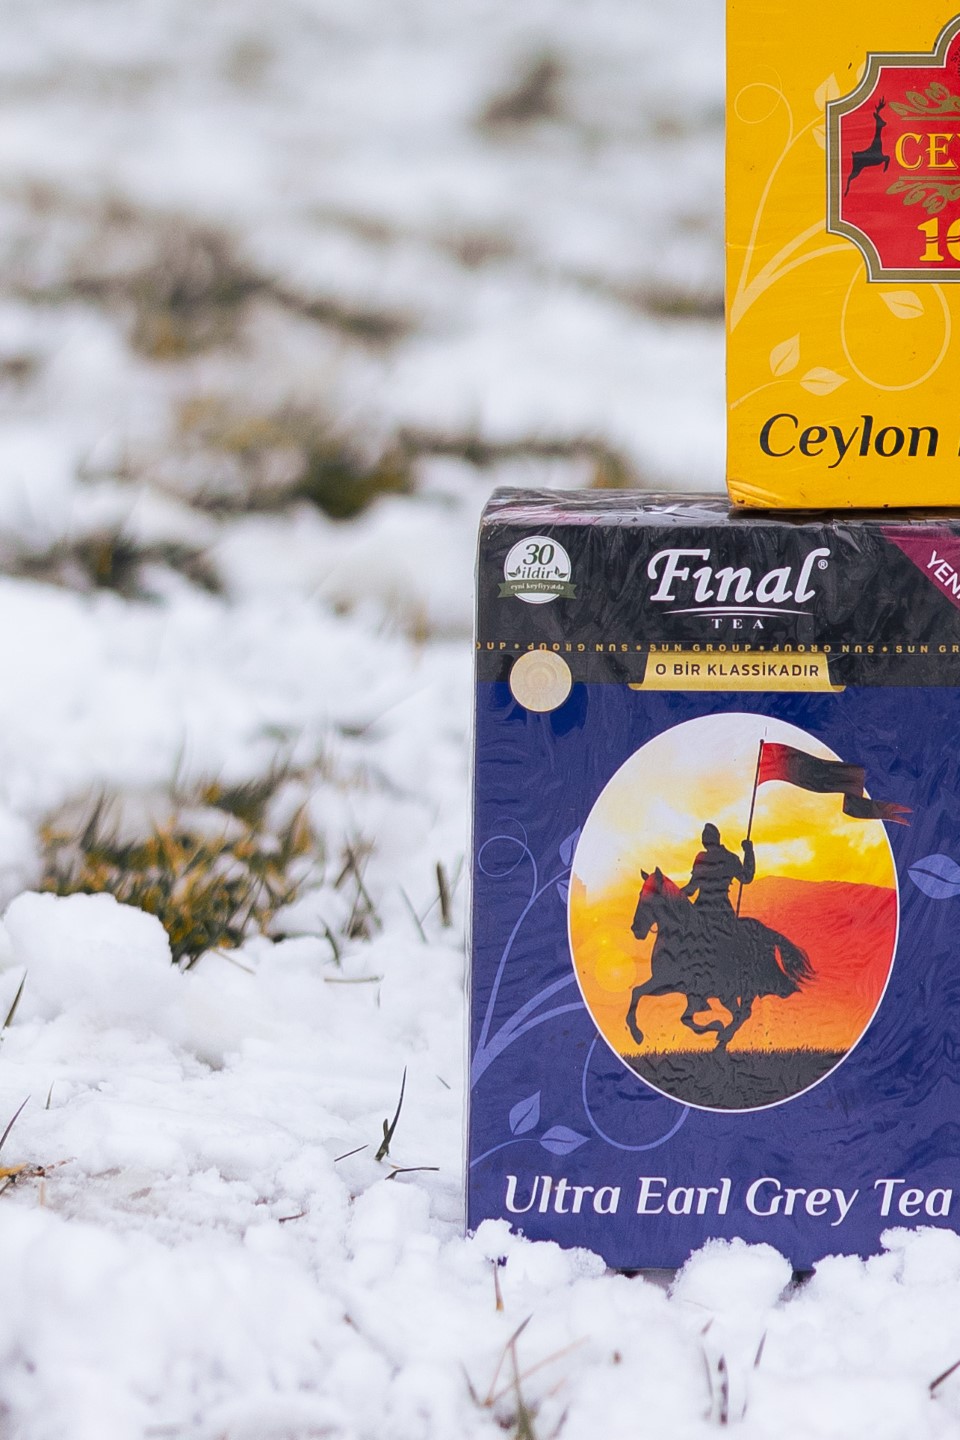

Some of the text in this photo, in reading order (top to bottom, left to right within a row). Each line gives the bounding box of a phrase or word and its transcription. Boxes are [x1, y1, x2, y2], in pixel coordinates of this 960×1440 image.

[759, 413, 939, 469] Ceylon
[523, 544, 555, 565] 30
[522, 567, 554, 578] ildir
[711, 618, 764, 629] TEA
[650, 644, 751, 652] SUN GROUP
[896, 644, 929, 653] SUN
[655, 661, 819, 676] O BİR KLASSİKADIR
[505, 1175, 954, 1227] Ultra Earl Grey Tea
